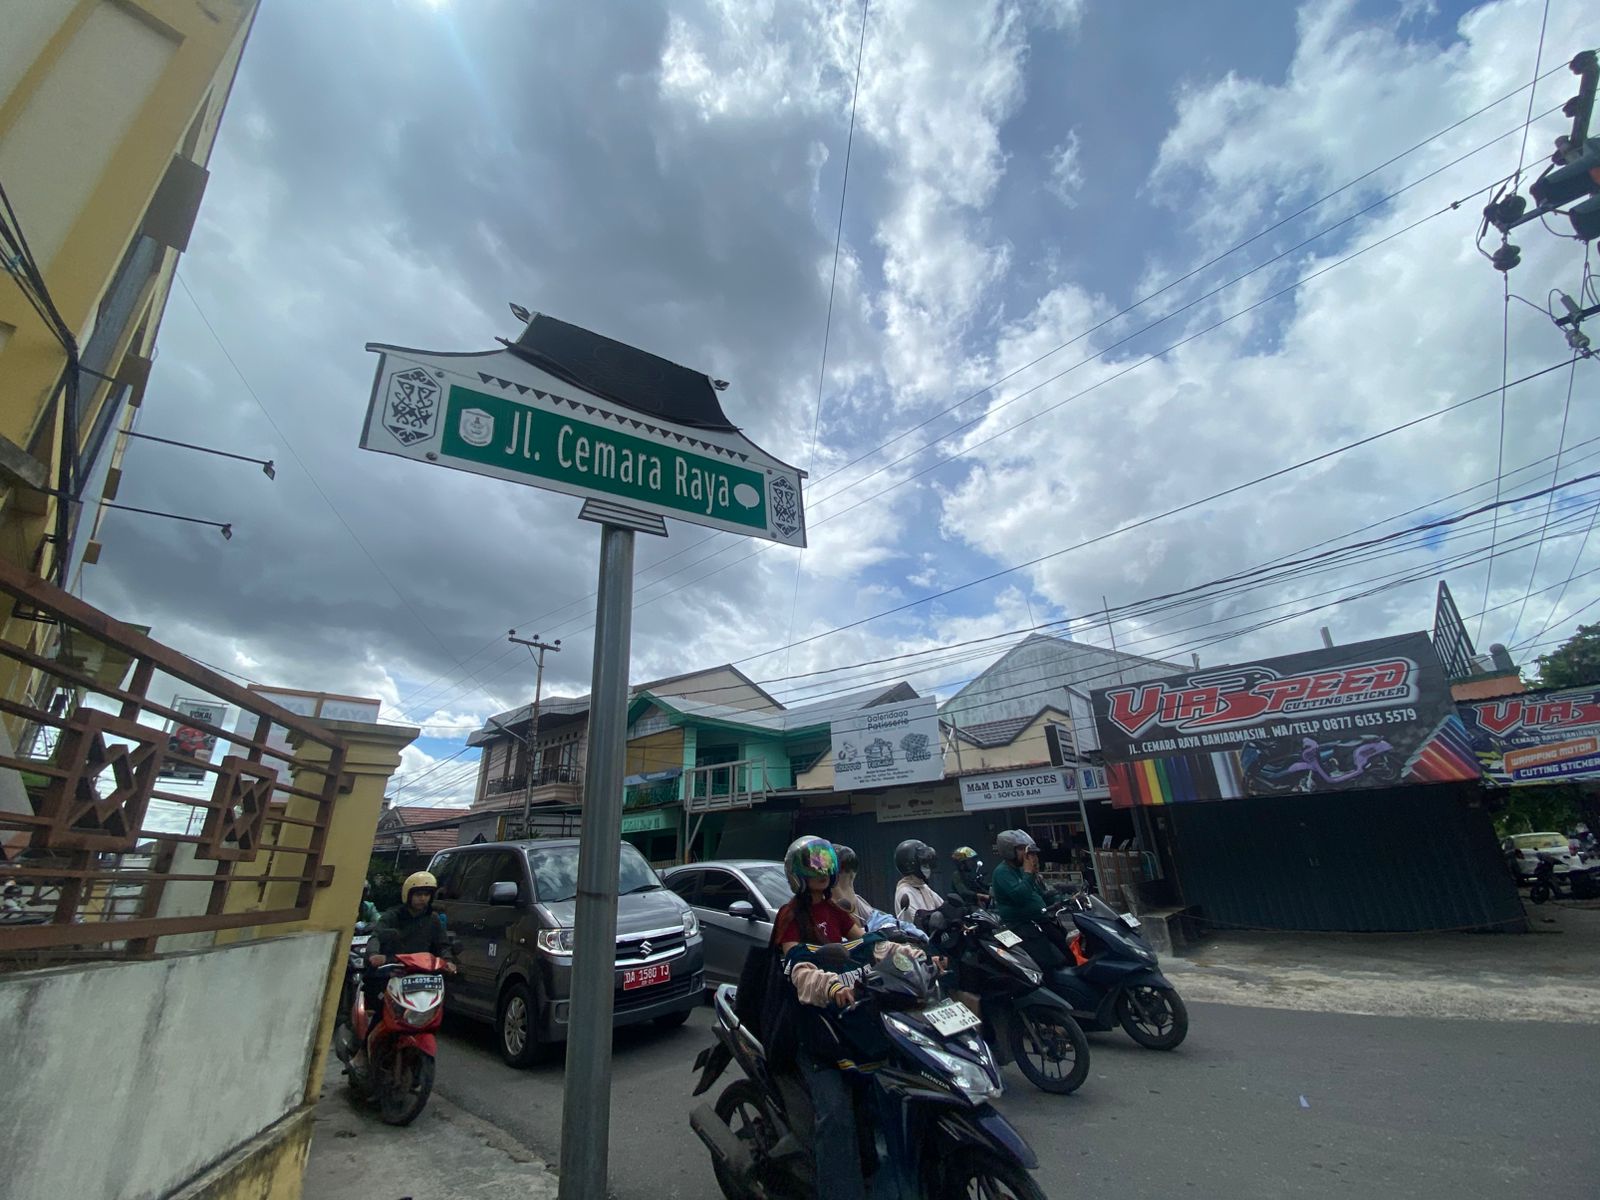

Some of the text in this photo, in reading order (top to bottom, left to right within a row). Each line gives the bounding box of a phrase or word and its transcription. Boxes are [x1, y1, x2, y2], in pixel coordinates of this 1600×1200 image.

[505, 410, 730, 515] Jl. Cemara Raya
[1284, 686, 1406, 711] CUTTING STICKER
[1129, 708, 1417, 756] JL. CEMARA RAYA BANJARMASIN. WA/TELP 0877 6133 5579
[1511, 743, 1592, 766] WRAPPING MOTOR
[1520, 763, 1559, 777] CUTTING
[966, 774, 1057, 793] M&M BJM SOFCES
[998, 790, 1025, 799] SOFCES
[1026, 788, 1041, 797] BJM
[624, 971, 636, 983] DA
[638, 967, 657, 981] 1580
